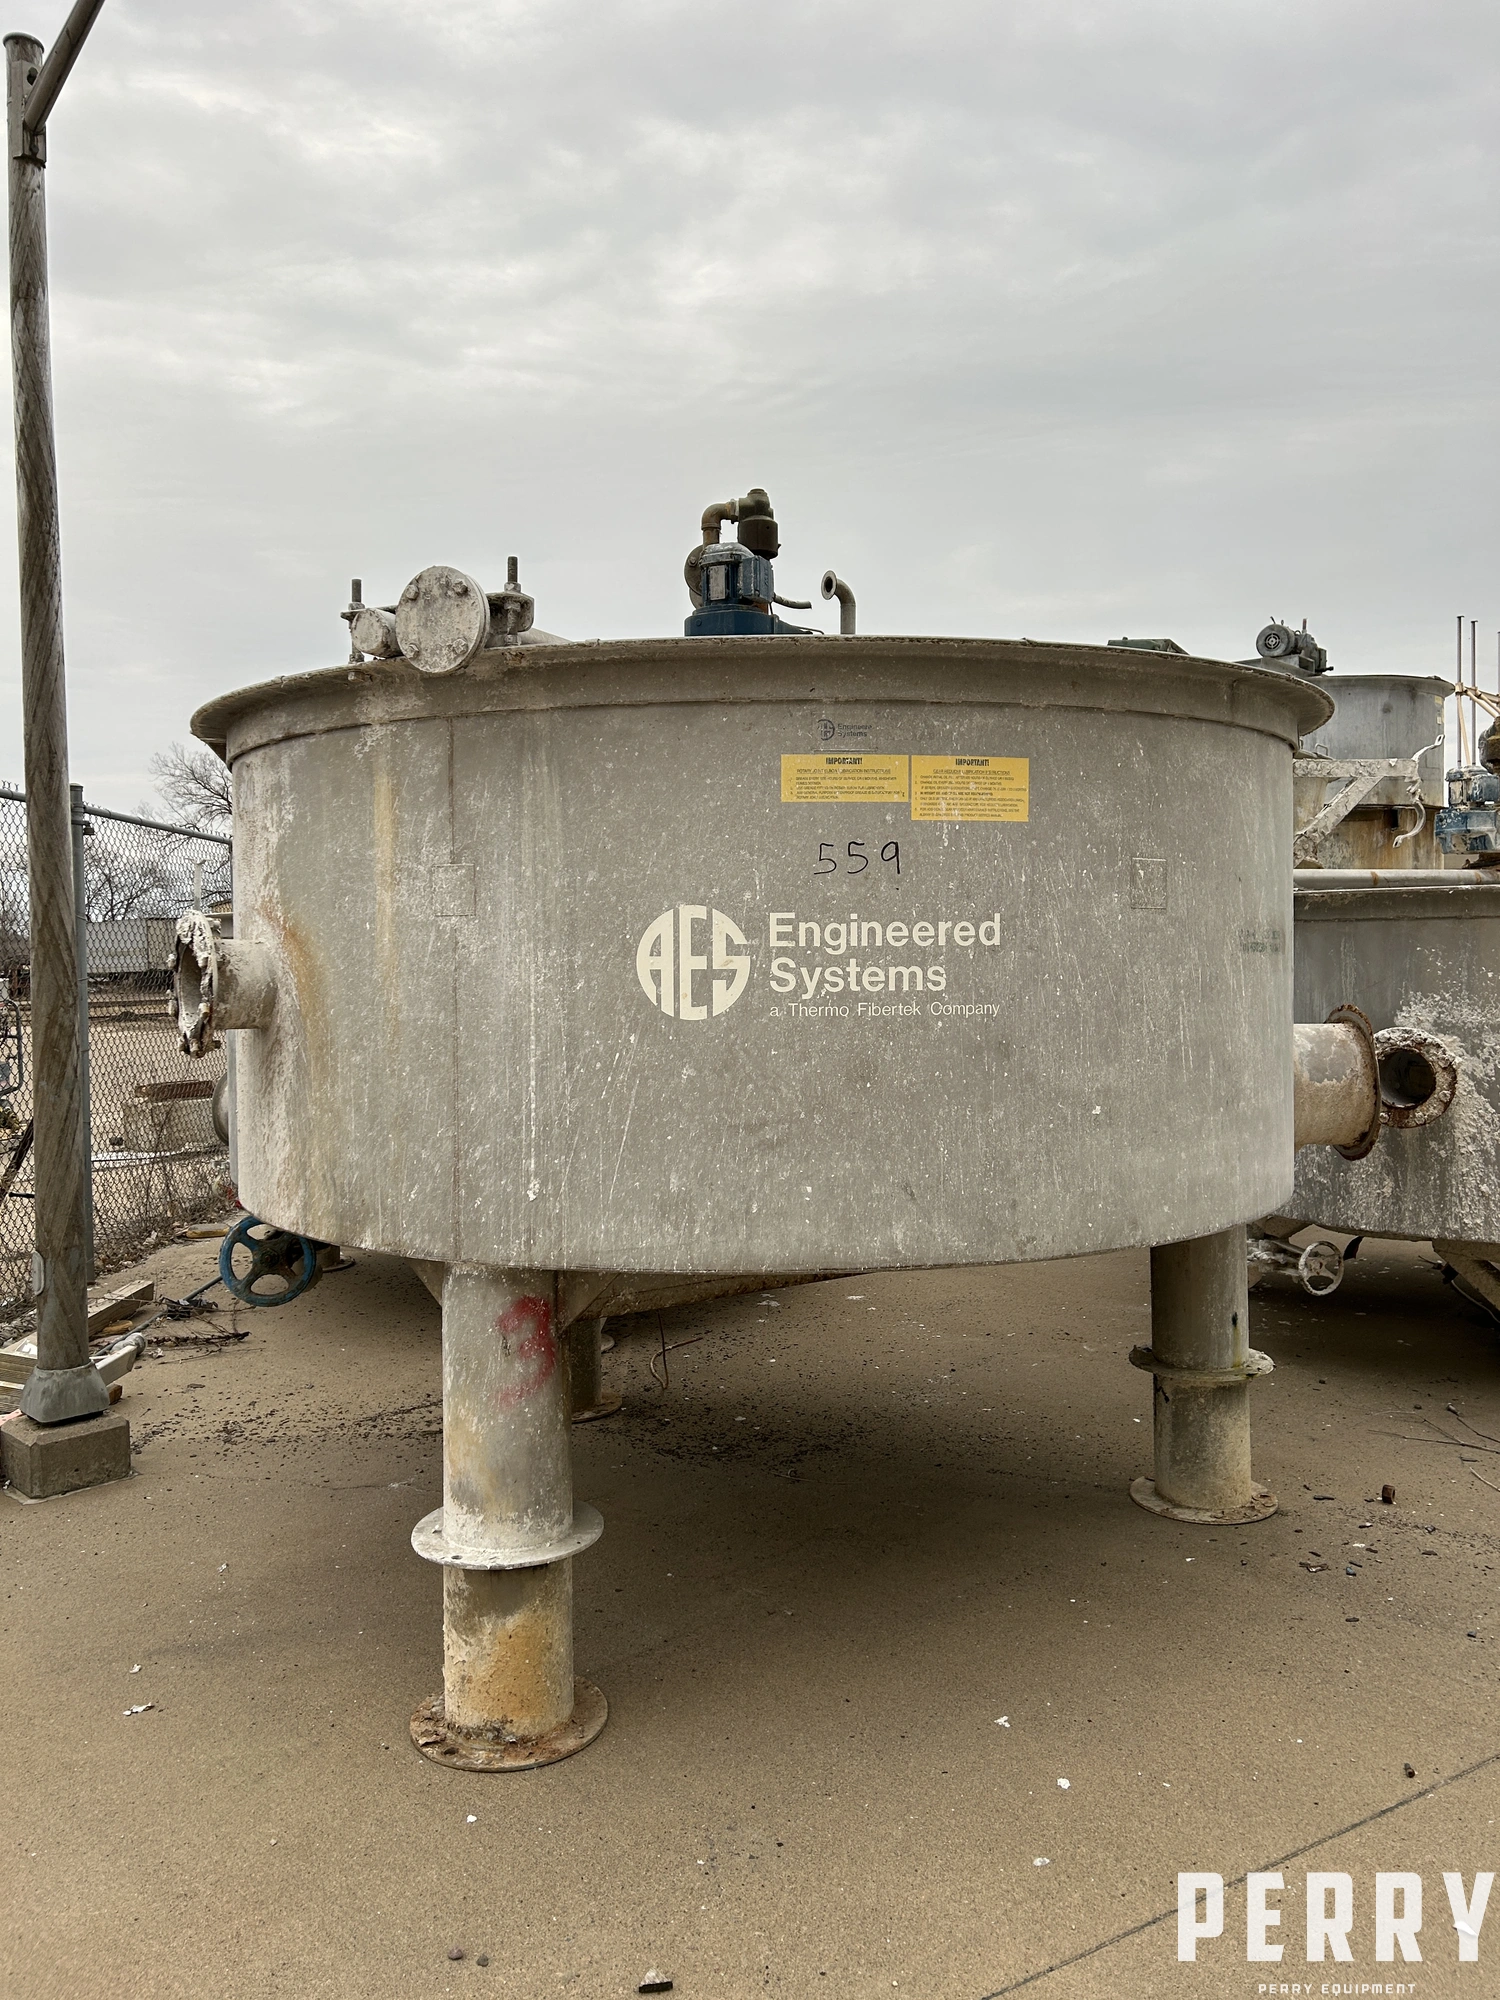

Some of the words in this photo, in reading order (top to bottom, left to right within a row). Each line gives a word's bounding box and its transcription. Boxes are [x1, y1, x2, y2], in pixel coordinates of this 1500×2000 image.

[837, 723, 873, 731] Engineere
[837, 731, 868, 739] Systems
[825, 757, 863, 765] IMPORTANT!
[955, 758, 990, 767] IMPORTANT!
[813, 841, 901, 875] 559
[768, 912, 1001, 955] Engineered
[636, 905, 751, 1021] AES
[768, 957, 948, 1000] Systems
[769, 1006, 780, 1017] a
[788, 1003, 850, 1018] Thermo
[857, 1002, 922, 1017] Fibertek
[930, 1002, 1001, 1018] Company
